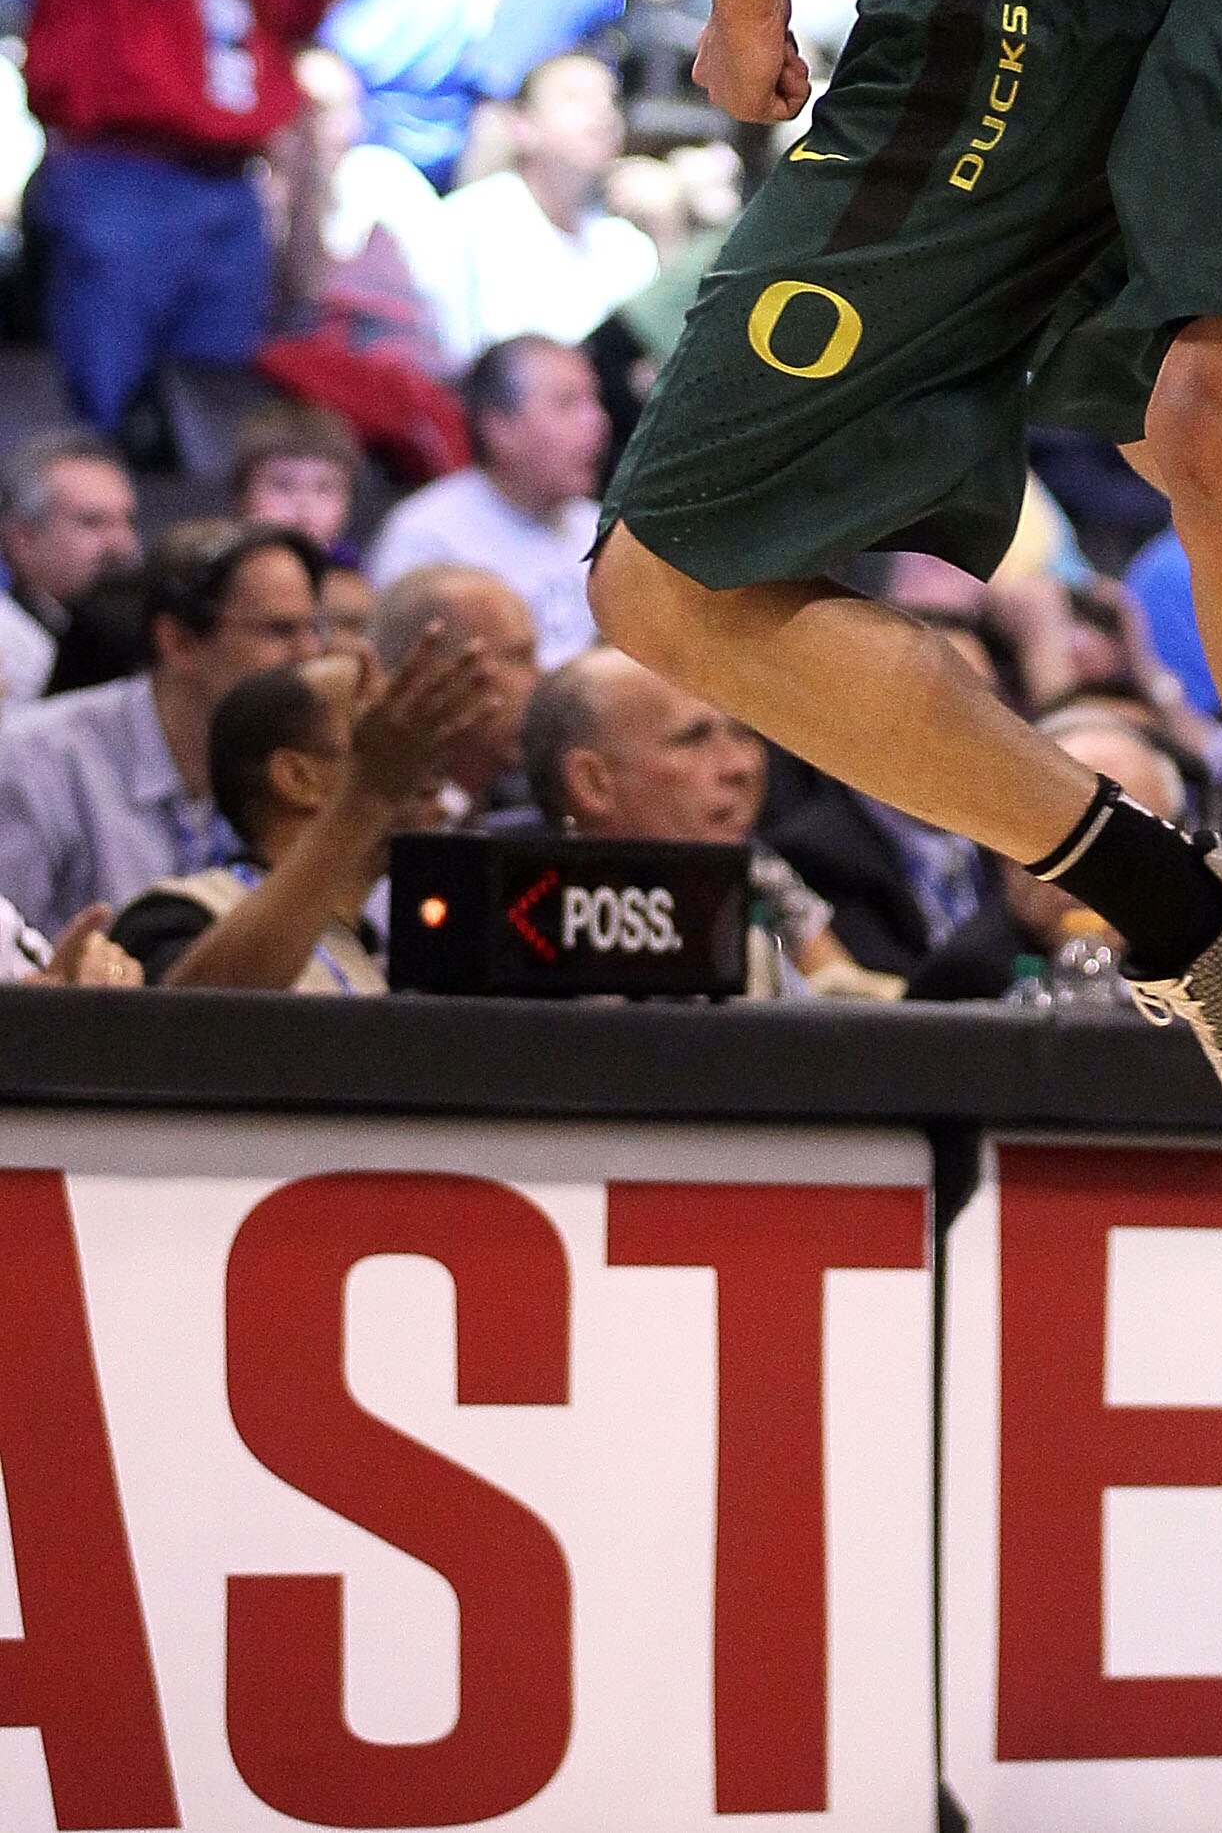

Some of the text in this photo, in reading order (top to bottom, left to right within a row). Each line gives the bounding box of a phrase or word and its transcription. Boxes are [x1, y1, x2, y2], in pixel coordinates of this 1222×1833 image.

[948, 3, 1029, 192] DUCKS
[747, 279, 863, 379] O
[561, 885, 684, 952] POSS.
